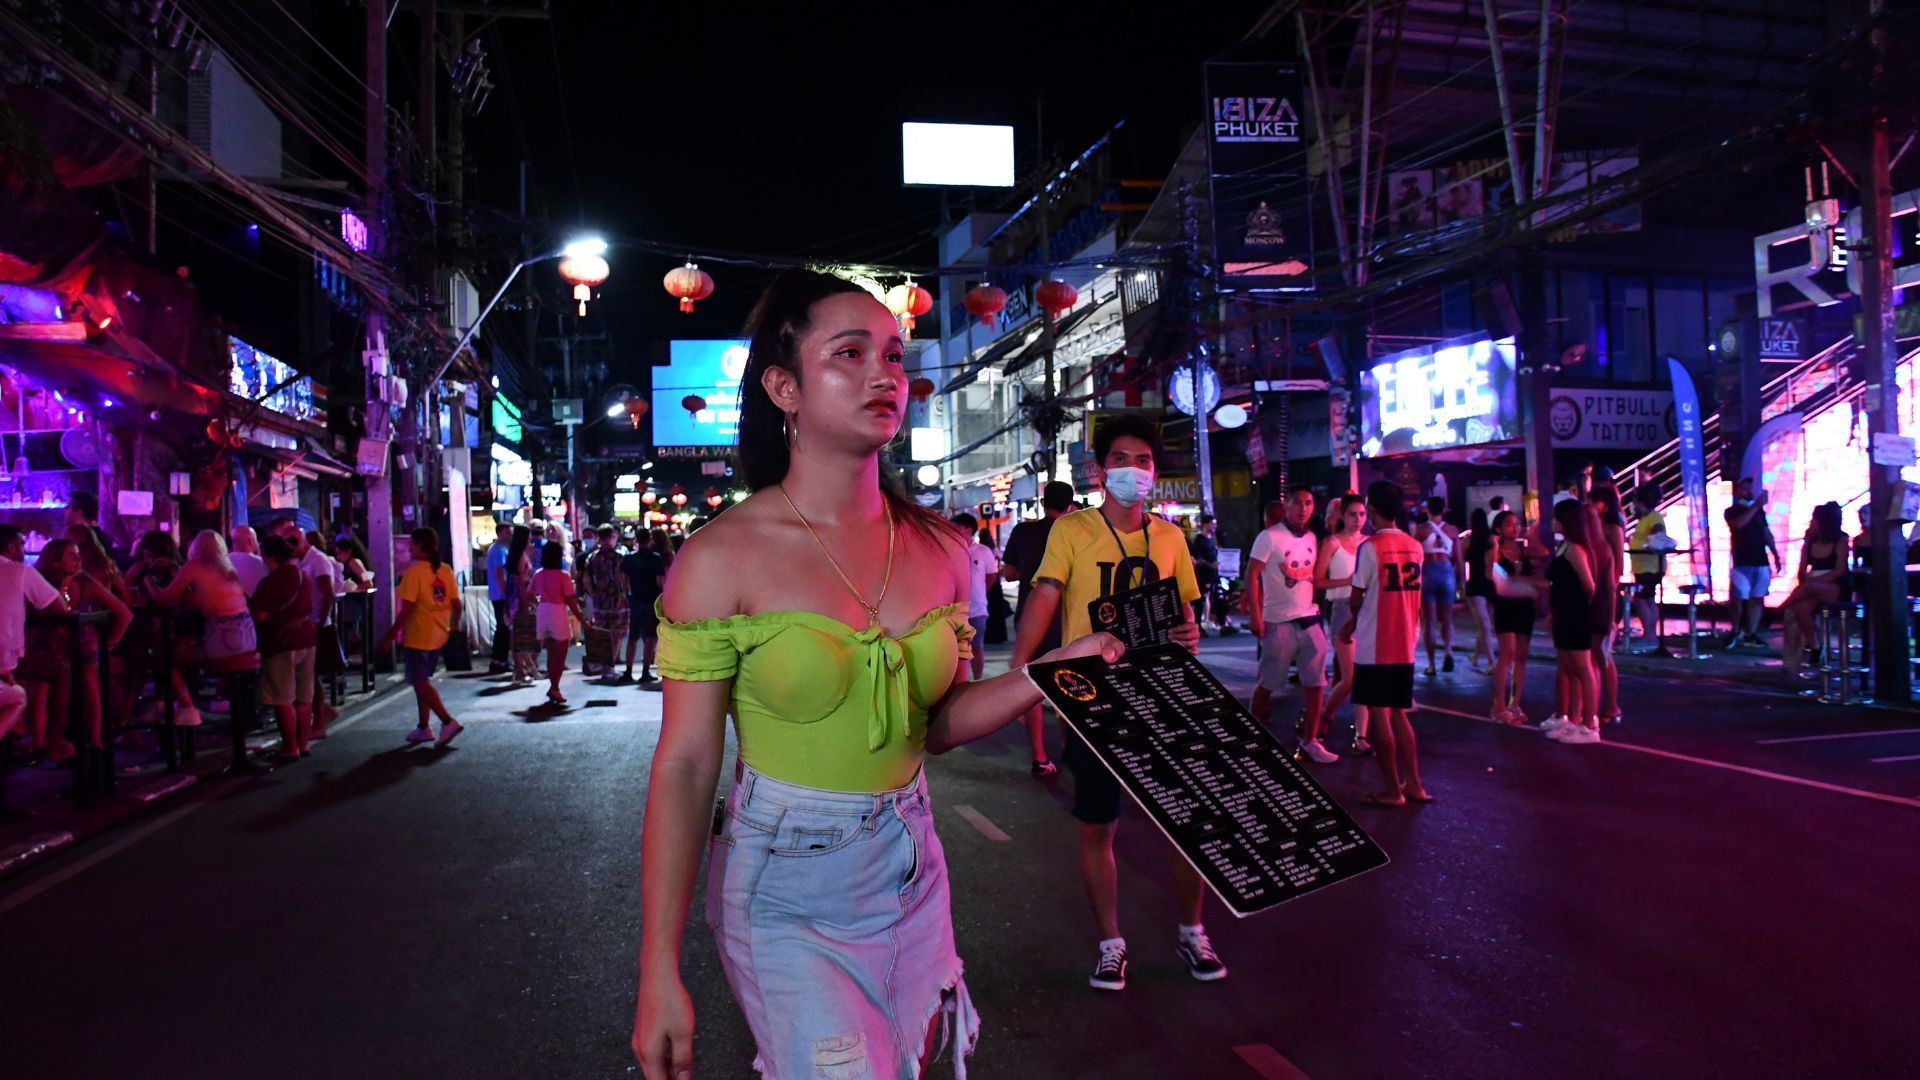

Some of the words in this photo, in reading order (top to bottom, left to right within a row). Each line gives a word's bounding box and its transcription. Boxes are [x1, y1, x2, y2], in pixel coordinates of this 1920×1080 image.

[1213, 97, 1299, 121] IBIZA
[1214, 122, 1299, 136] PHUKET
[1244, 236, 1285, 245] MOSCOW
[1761, 321, 1799, 339] IZA
[1761, 341, 1799, 351] UKET
[1584, 397, 1660, 416] PITBULL
[1590, 423, 1657, 440] TATTOO
[657, 446, 708, 457] BANGLA
[1383, 562, 1421, 592] 12
